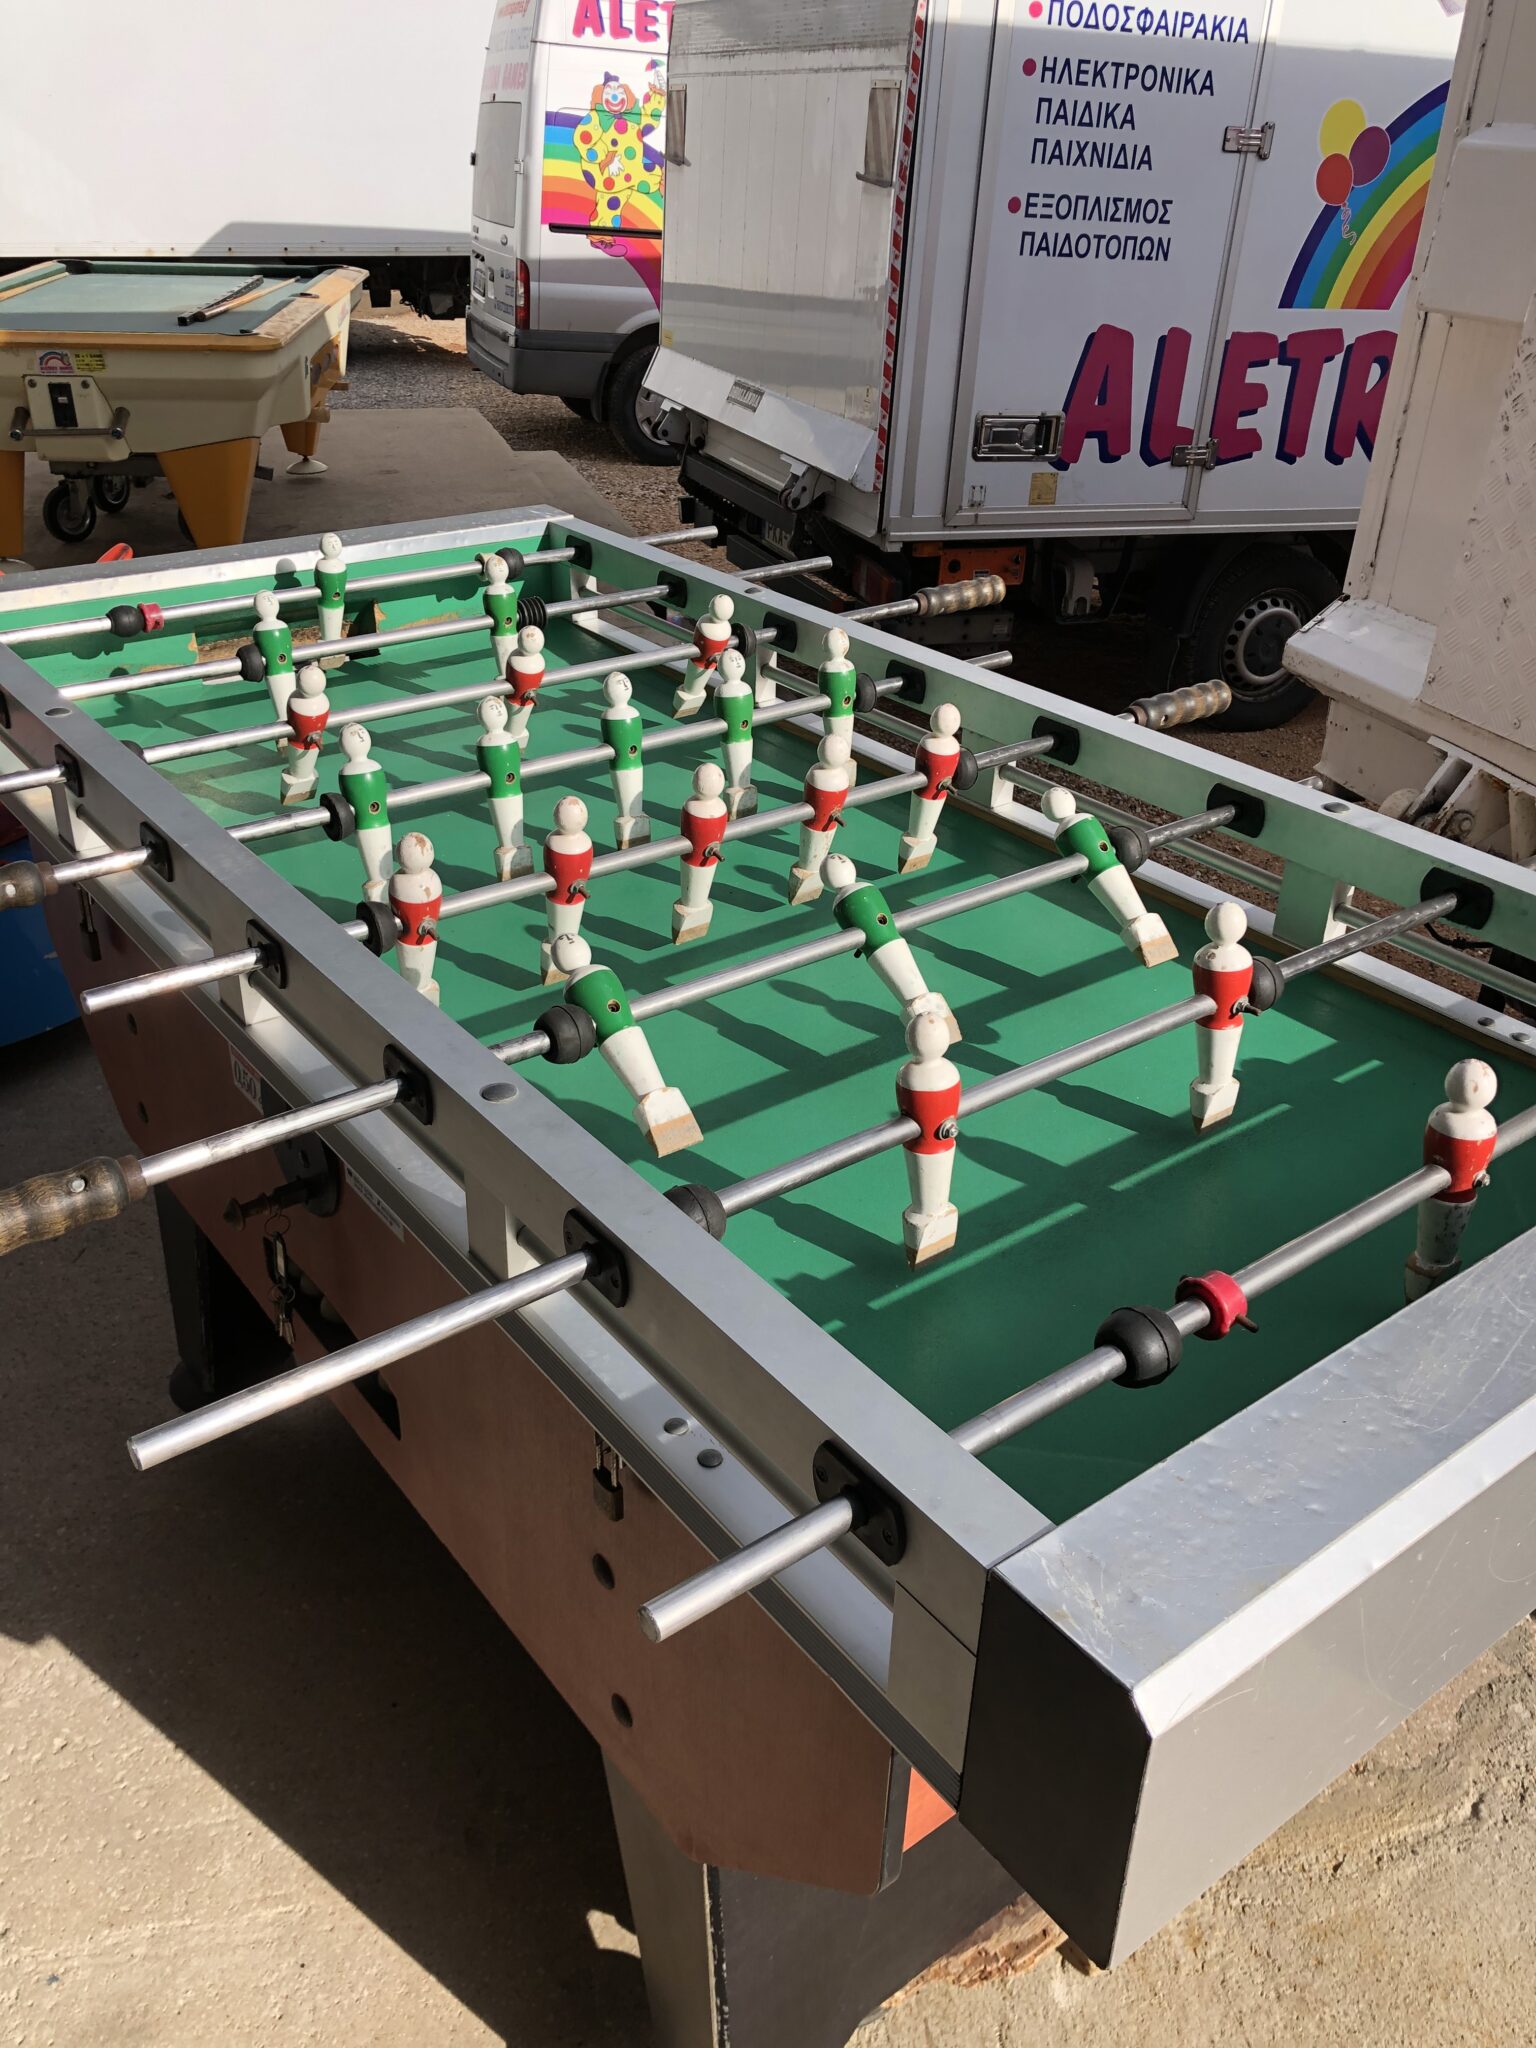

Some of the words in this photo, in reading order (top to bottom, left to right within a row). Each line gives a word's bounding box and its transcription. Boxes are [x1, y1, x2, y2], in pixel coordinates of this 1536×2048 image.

[1047, 0, 1249, 44] ΠΟΔΟΣΦΑΙΡΑΚΙΑ
[1040, 56, 1214, 97] ΗΛΕΚΤΡΟΝΙΚΑ
[1035, 97, 1136, 131] ΠΑΙΔΙΚΑ
[1030, 137, 1153, 171] ΠΑΙΧΝΙΔΙΑ
[1024, 192, 1174, 225] ΕΞΟΠΛΙΣΜΟΣ
[1019, 230, 1172, 262] ΠΑΙΔΟΤΟΠΩΝ
